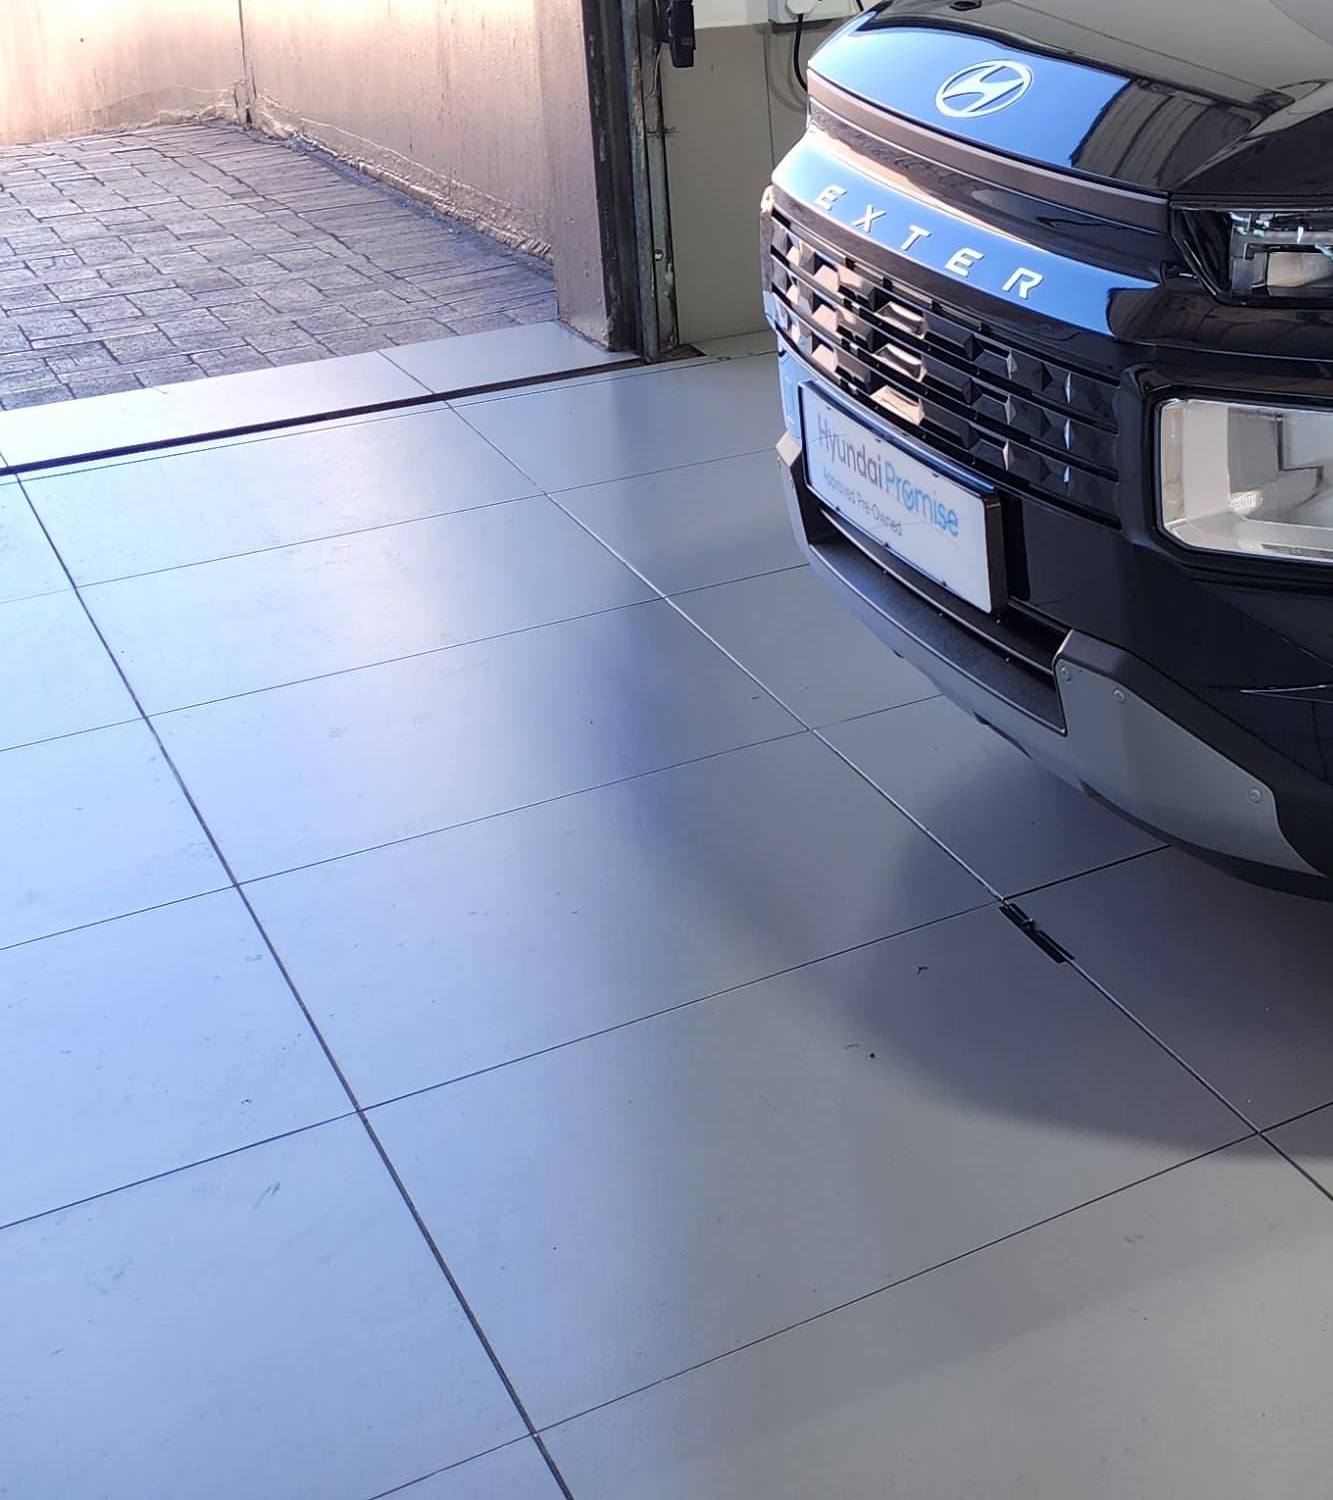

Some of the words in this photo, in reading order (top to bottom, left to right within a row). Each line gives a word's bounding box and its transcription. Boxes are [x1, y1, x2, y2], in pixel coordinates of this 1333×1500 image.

[813, 183, 1046, 300] EXTER
[817, 411, 883, 490] Hyundai
[884, 460, 960, 538] Promise
